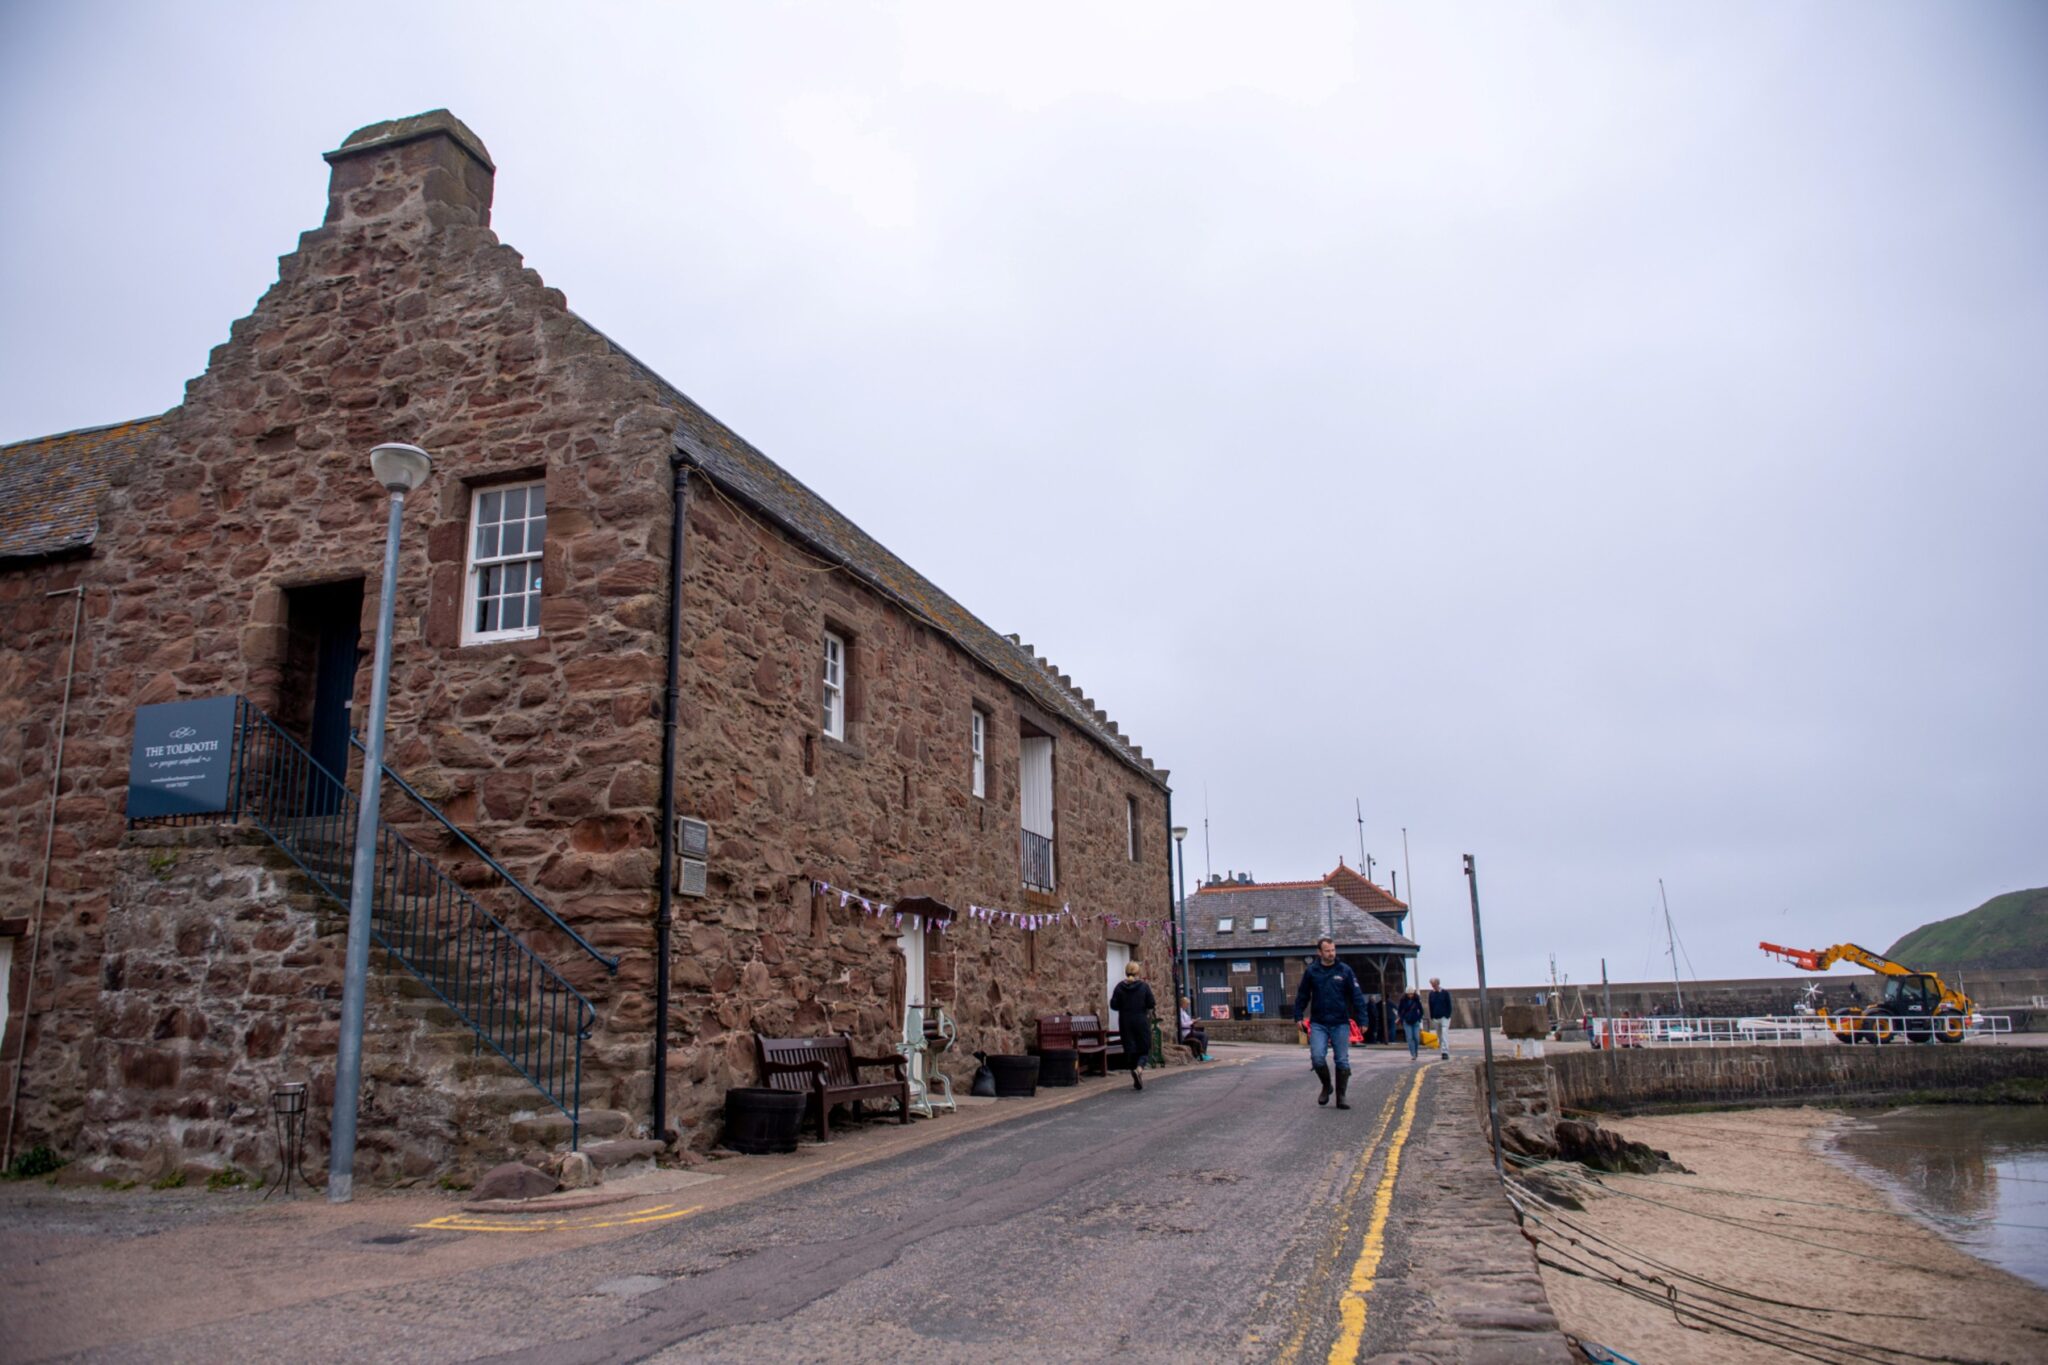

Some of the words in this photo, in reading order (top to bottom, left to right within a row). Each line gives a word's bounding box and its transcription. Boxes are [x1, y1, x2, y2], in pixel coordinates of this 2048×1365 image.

[145, 746, 164, 757] THE
[166, 740, 218, 755] TOLBOOTH
[1251, 994, 1261, 1008] P
